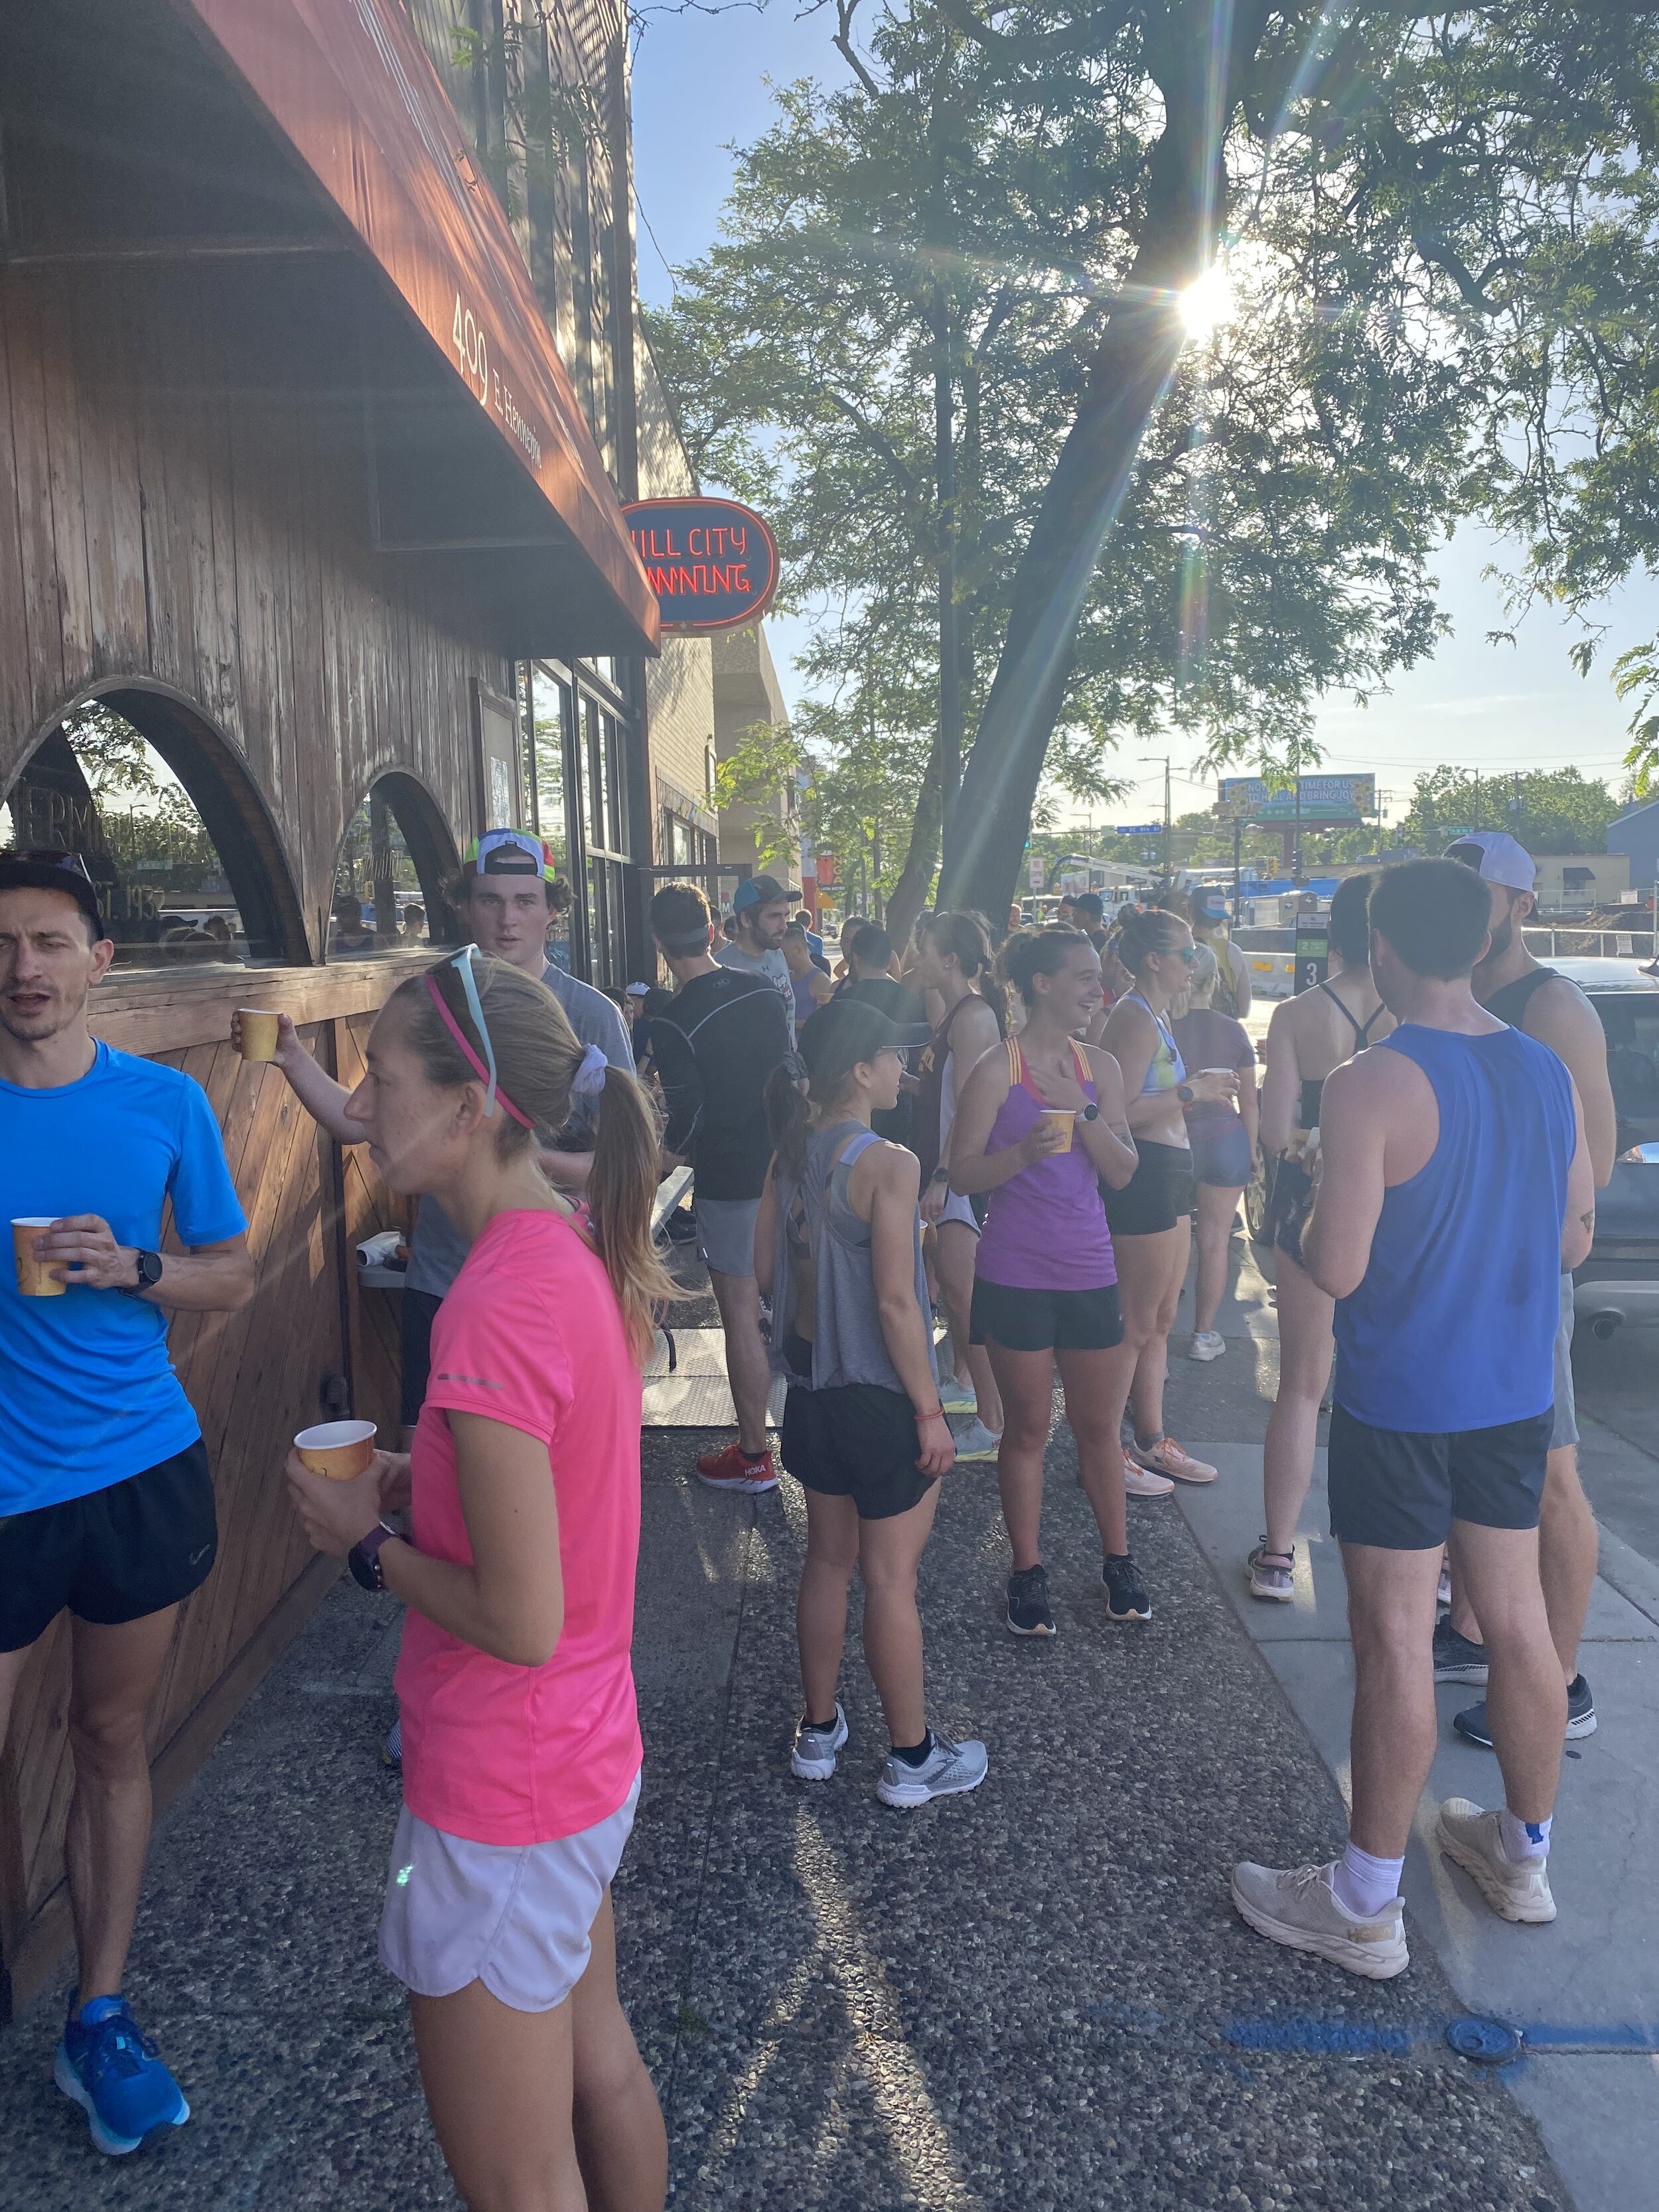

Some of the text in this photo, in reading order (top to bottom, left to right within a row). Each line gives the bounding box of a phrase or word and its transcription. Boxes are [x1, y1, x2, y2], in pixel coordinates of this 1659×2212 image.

[452, 291, 542, 469] 409 E. Hennepin
[689, 527, 746, 556] CITY
[1299, 780, 1321, 790] TIME
[1323, 780, 1339, 790] FOR
[1342, 779, 1354, 789] US
[1248, 792, 1259, 802] TO
[1261, 791, 1284, 802] HAL
[1307, 790, 1336, 800] BRING
[1336, 789, 1354, 800] JOY
[1301, 942, 1309, 950] 2
[1306, 962, 1317, 986] 3
[744, 1464, 766, 1477] HOKA
